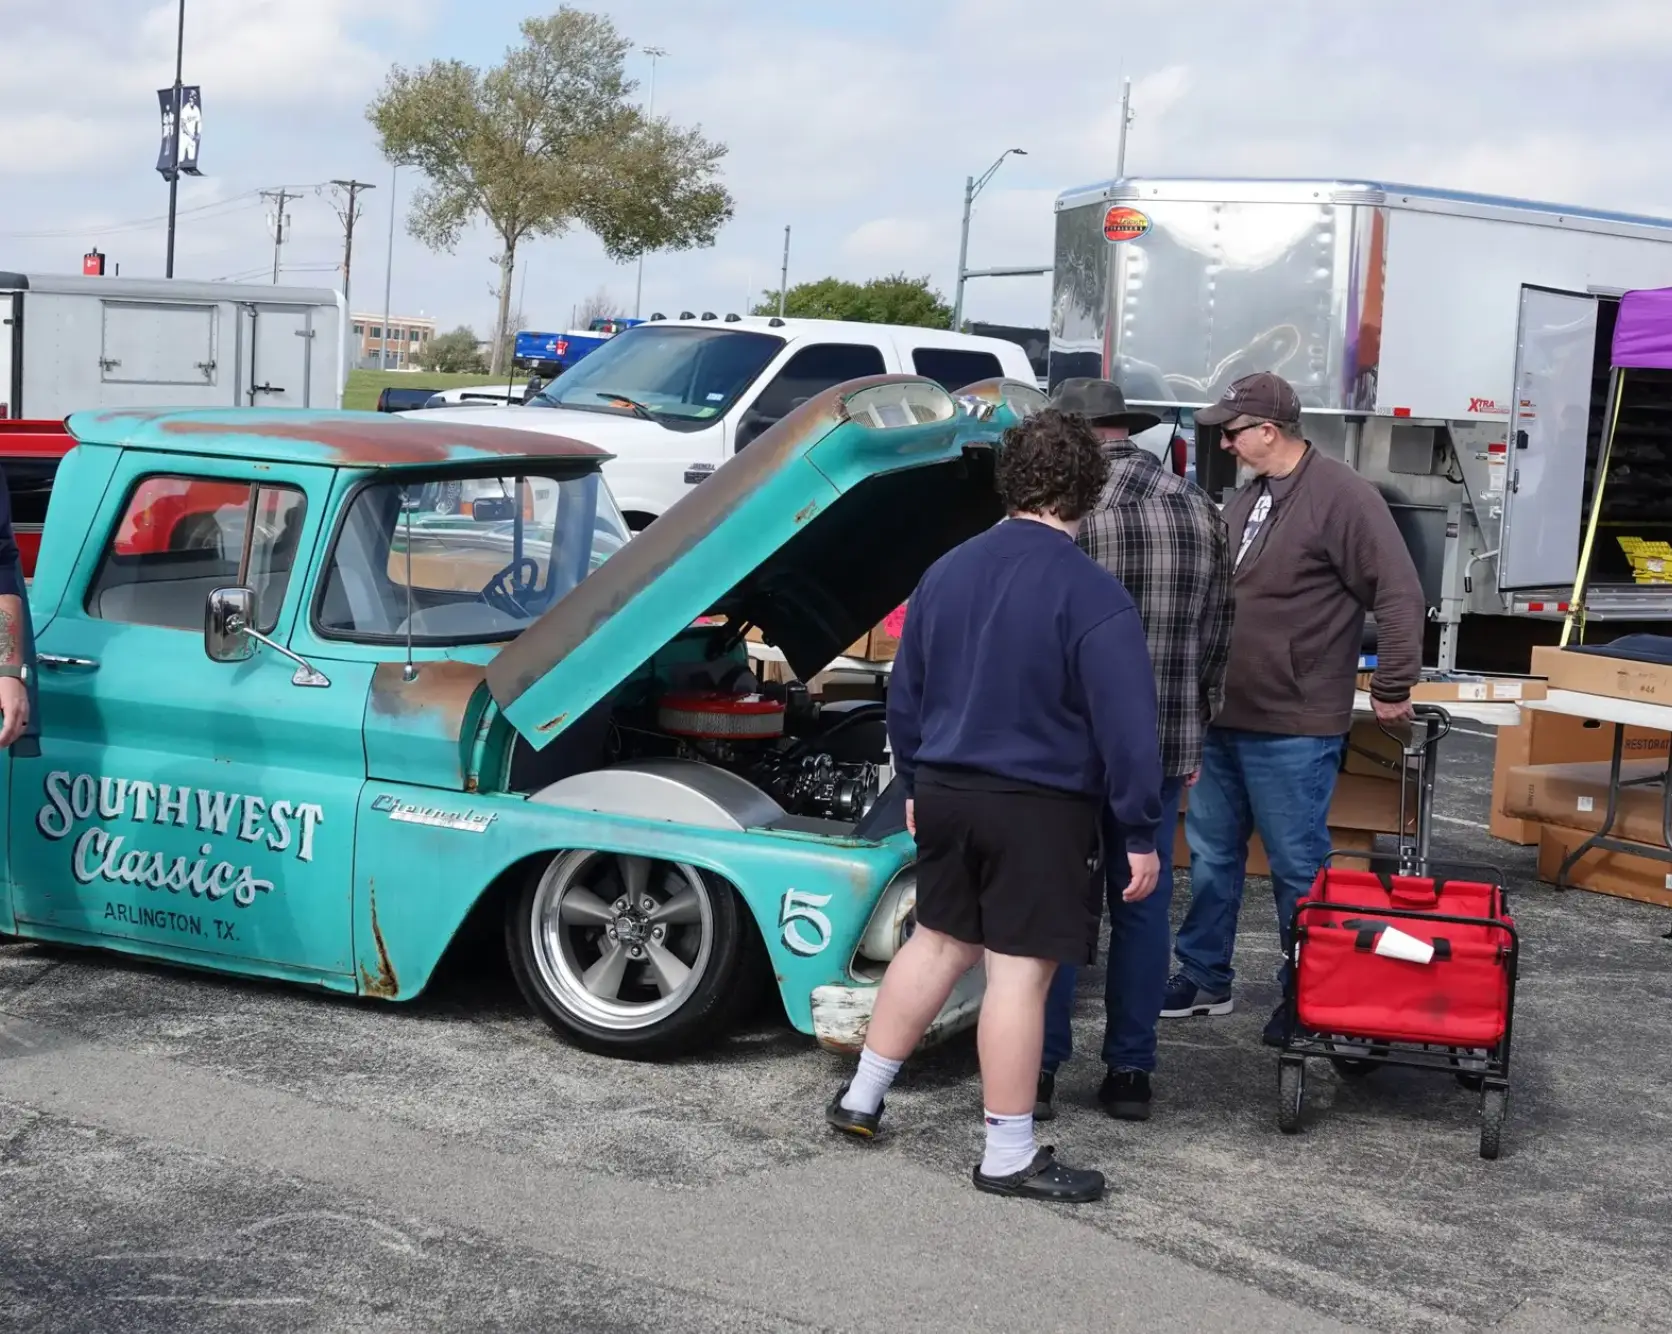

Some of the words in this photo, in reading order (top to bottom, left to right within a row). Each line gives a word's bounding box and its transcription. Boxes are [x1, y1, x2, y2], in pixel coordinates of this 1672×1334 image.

[1467, 397, 1495, 412] XTRA
[36, 770, 324, 863] SOUTHWEST
[371, 794, 499, 826] Chevrolet
[71, 826, 274, 908] Classics
[103, 901, 209, 936] ARLINGTON,
[213, 919, 241, 941] TX.
[778, 888, 833, 957] 5
